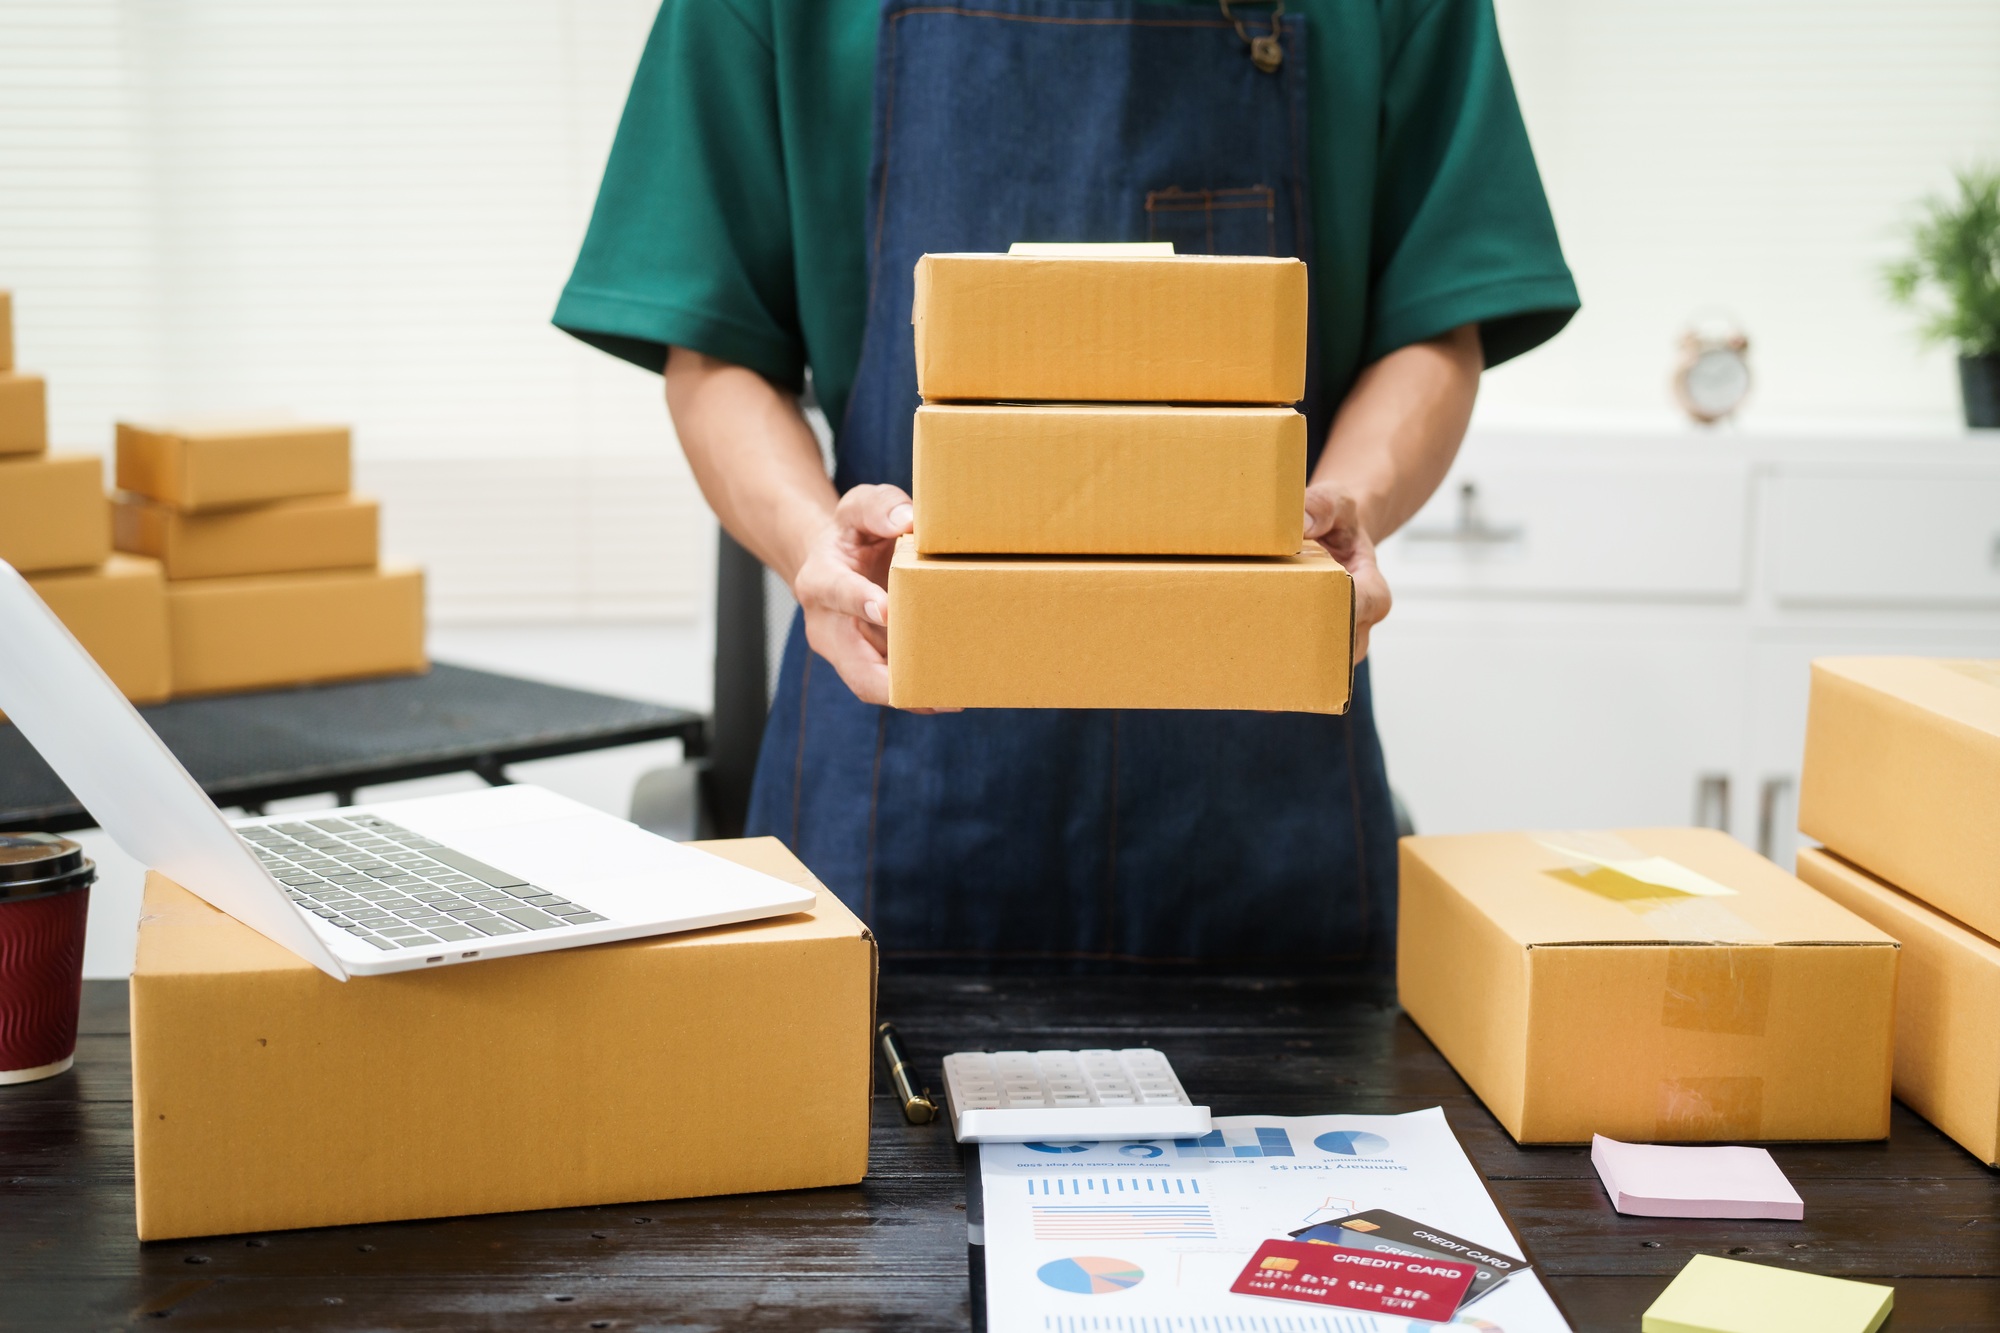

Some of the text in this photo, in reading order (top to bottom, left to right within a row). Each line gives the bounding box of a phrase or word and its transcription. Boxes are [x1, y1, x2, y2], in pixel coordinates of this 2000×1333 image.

[1412, 1230, 1511, 1269] CREDIT CARD
[1333, 1253, 1404, 1270] CREDIT
[1406, 1264, 1462, 1279] CARD
